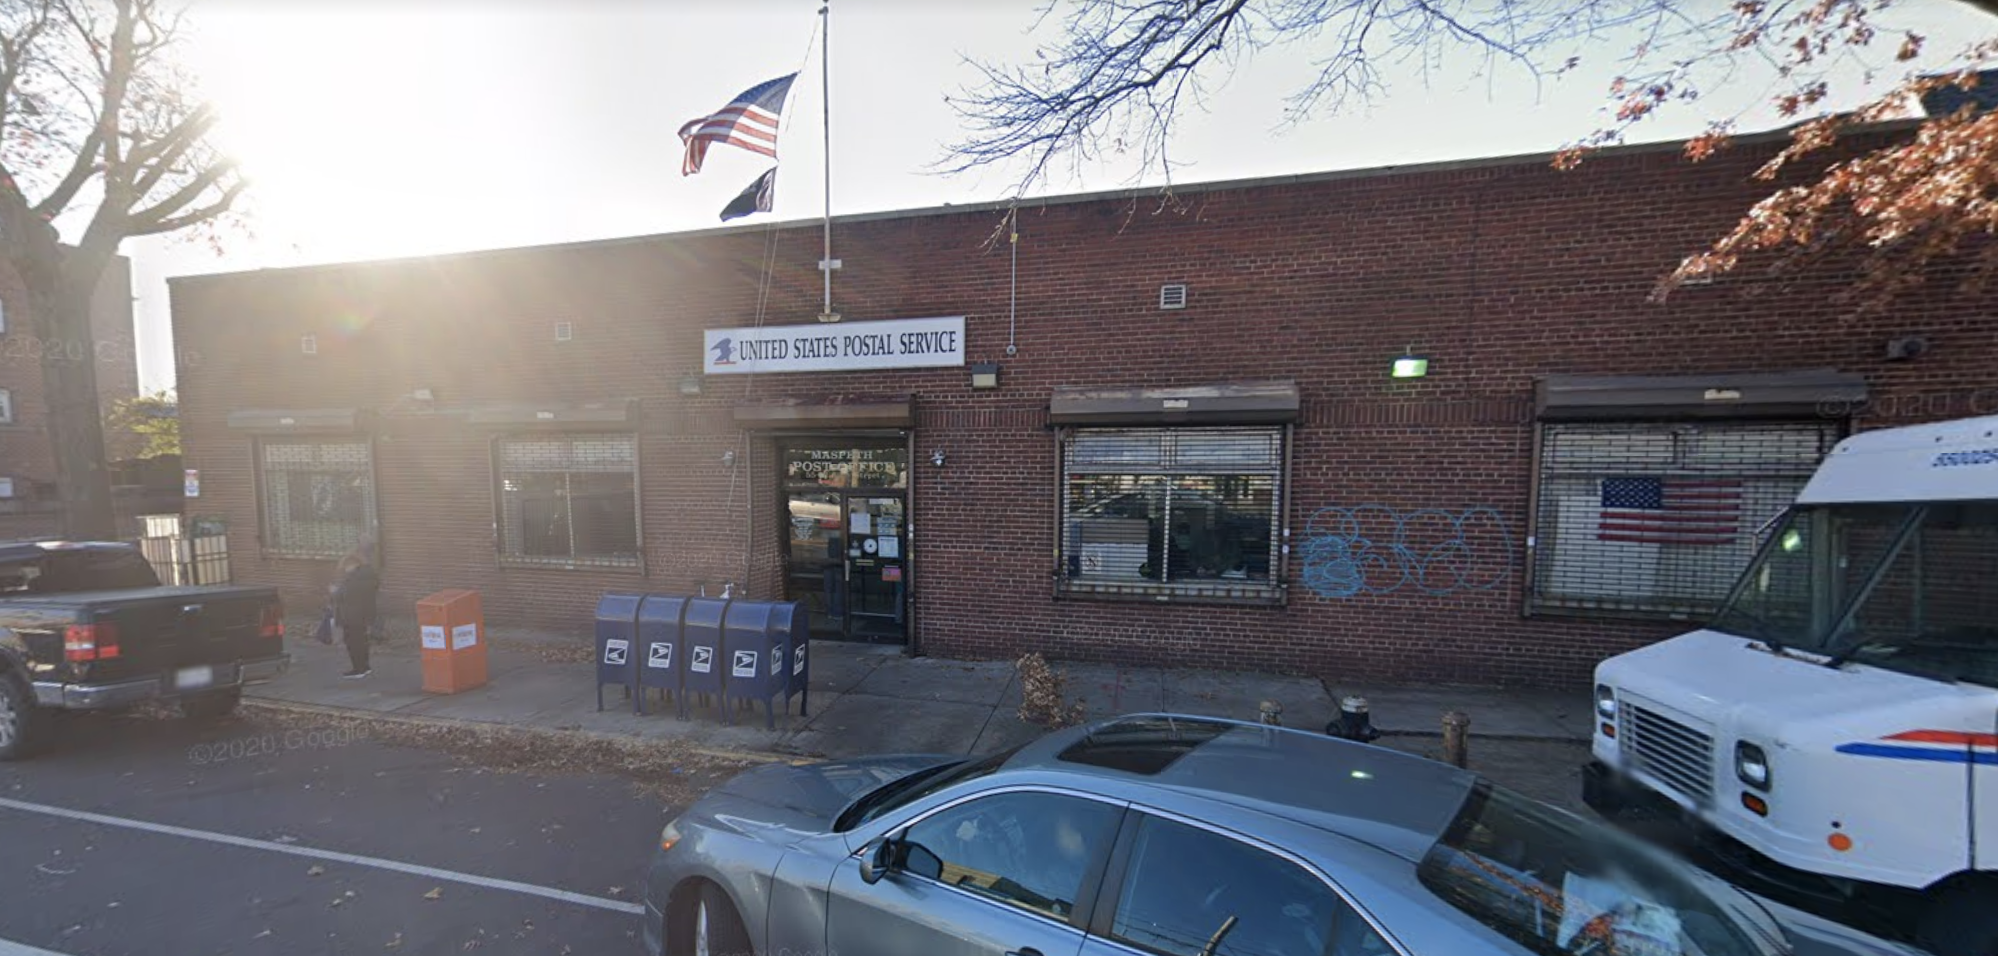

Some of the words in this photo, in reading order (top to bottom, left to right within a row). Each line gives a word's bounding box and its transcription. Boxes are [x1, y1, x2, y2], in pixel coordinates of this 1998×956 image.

[740, 339, 788, 361] UNITED
[794, 337, 838, 359] STATES
[843, 334, 894, 357] POSTAL
[900, 331, 956, 354] SERVICE
[793, 461, 831, 472] POST
